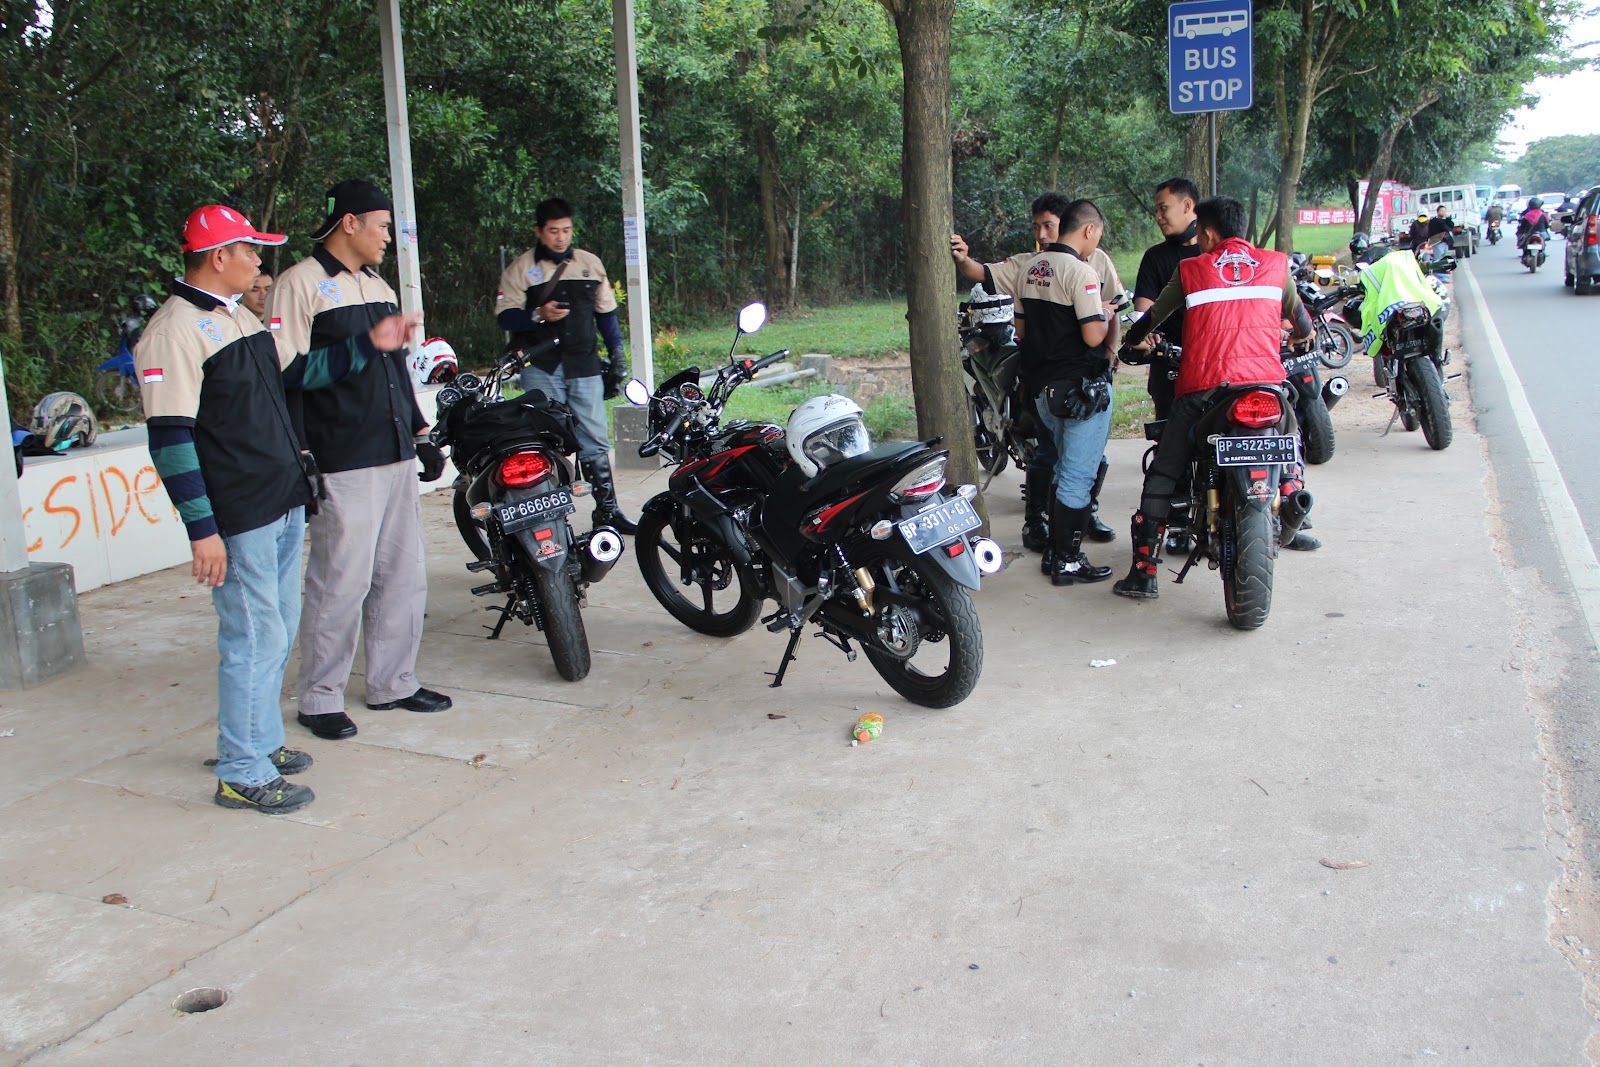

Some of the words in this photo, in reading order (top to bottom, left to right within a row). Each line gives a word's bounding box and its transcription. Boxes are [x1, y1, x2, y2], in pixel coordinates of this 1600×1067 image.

[1185, 46, 1236, 70] BUS
[1178, 78, 1242, 103] STOP
[710, 445, 732, 456] HONDA
[1219, 440, 1232, 452] BP
[1242, 440, 1271, 451] 5225
[501, 507, 516, 521] BP
[902, 522, 917, 539] BP
